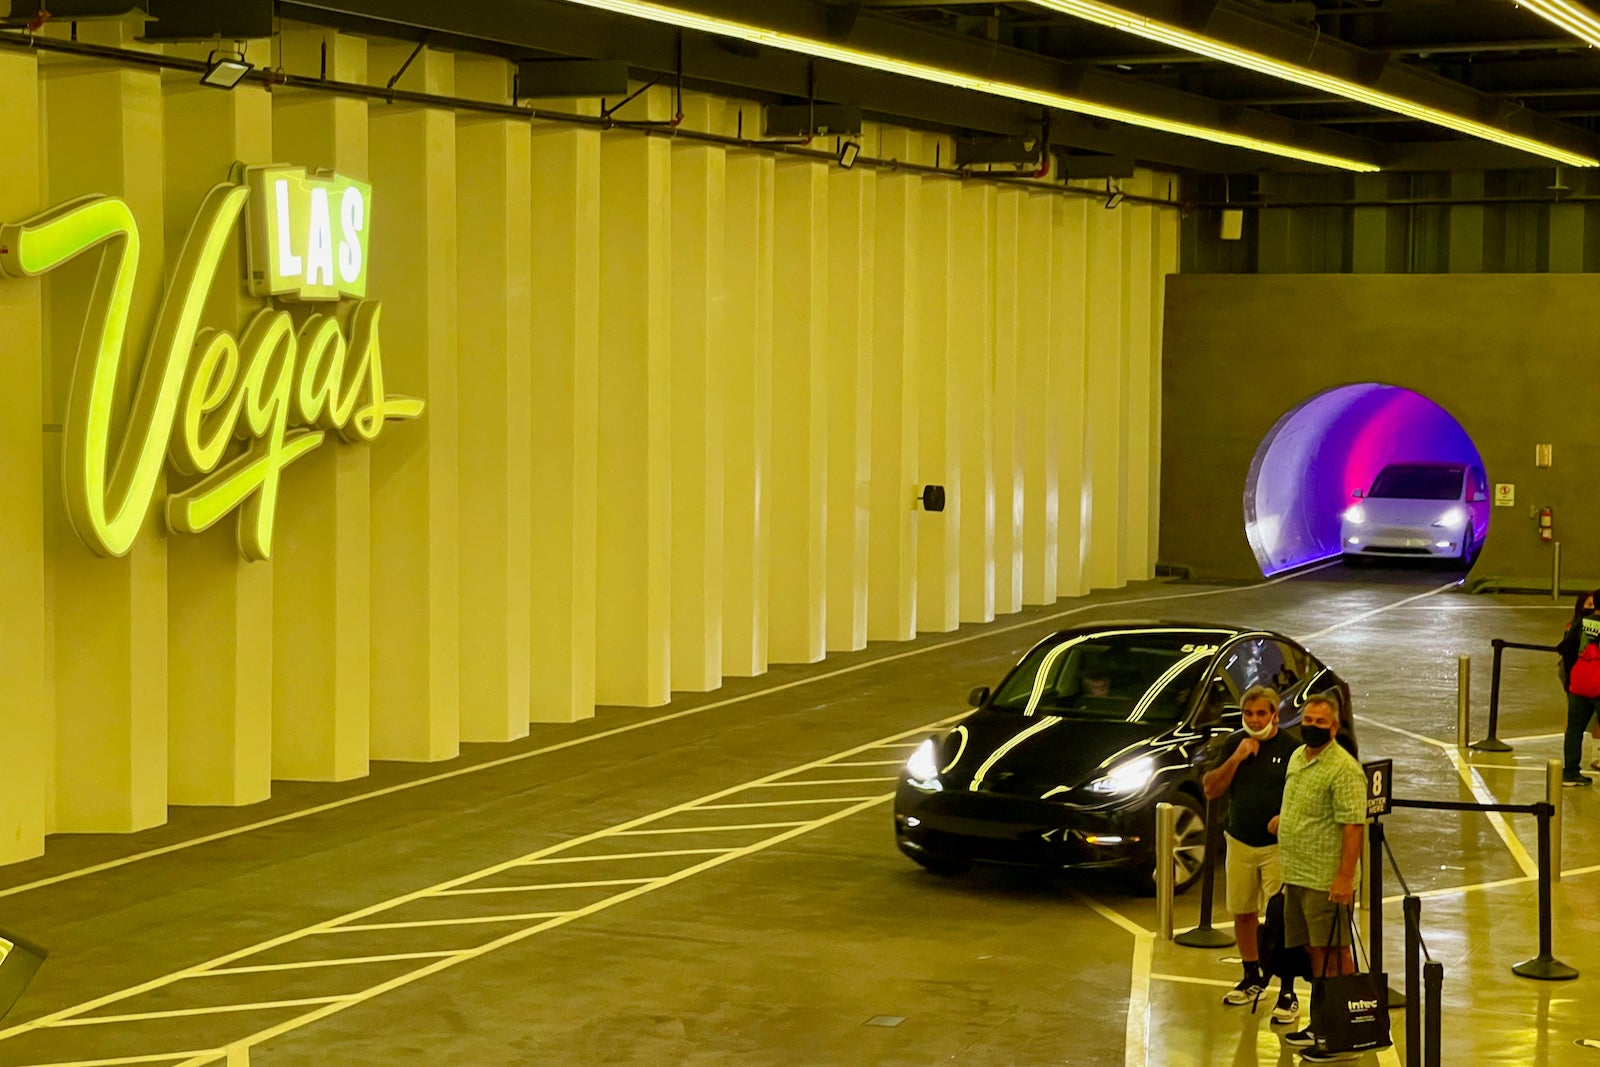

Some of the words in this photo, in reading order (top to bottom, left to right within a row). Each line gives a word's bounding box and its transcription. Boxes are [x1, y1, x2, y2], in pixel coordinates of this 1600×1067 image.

[275, 179, 364, 286] LAS
[12, 184, 426, 561] Vegas
[1372, 770, 1383, 797] 8
